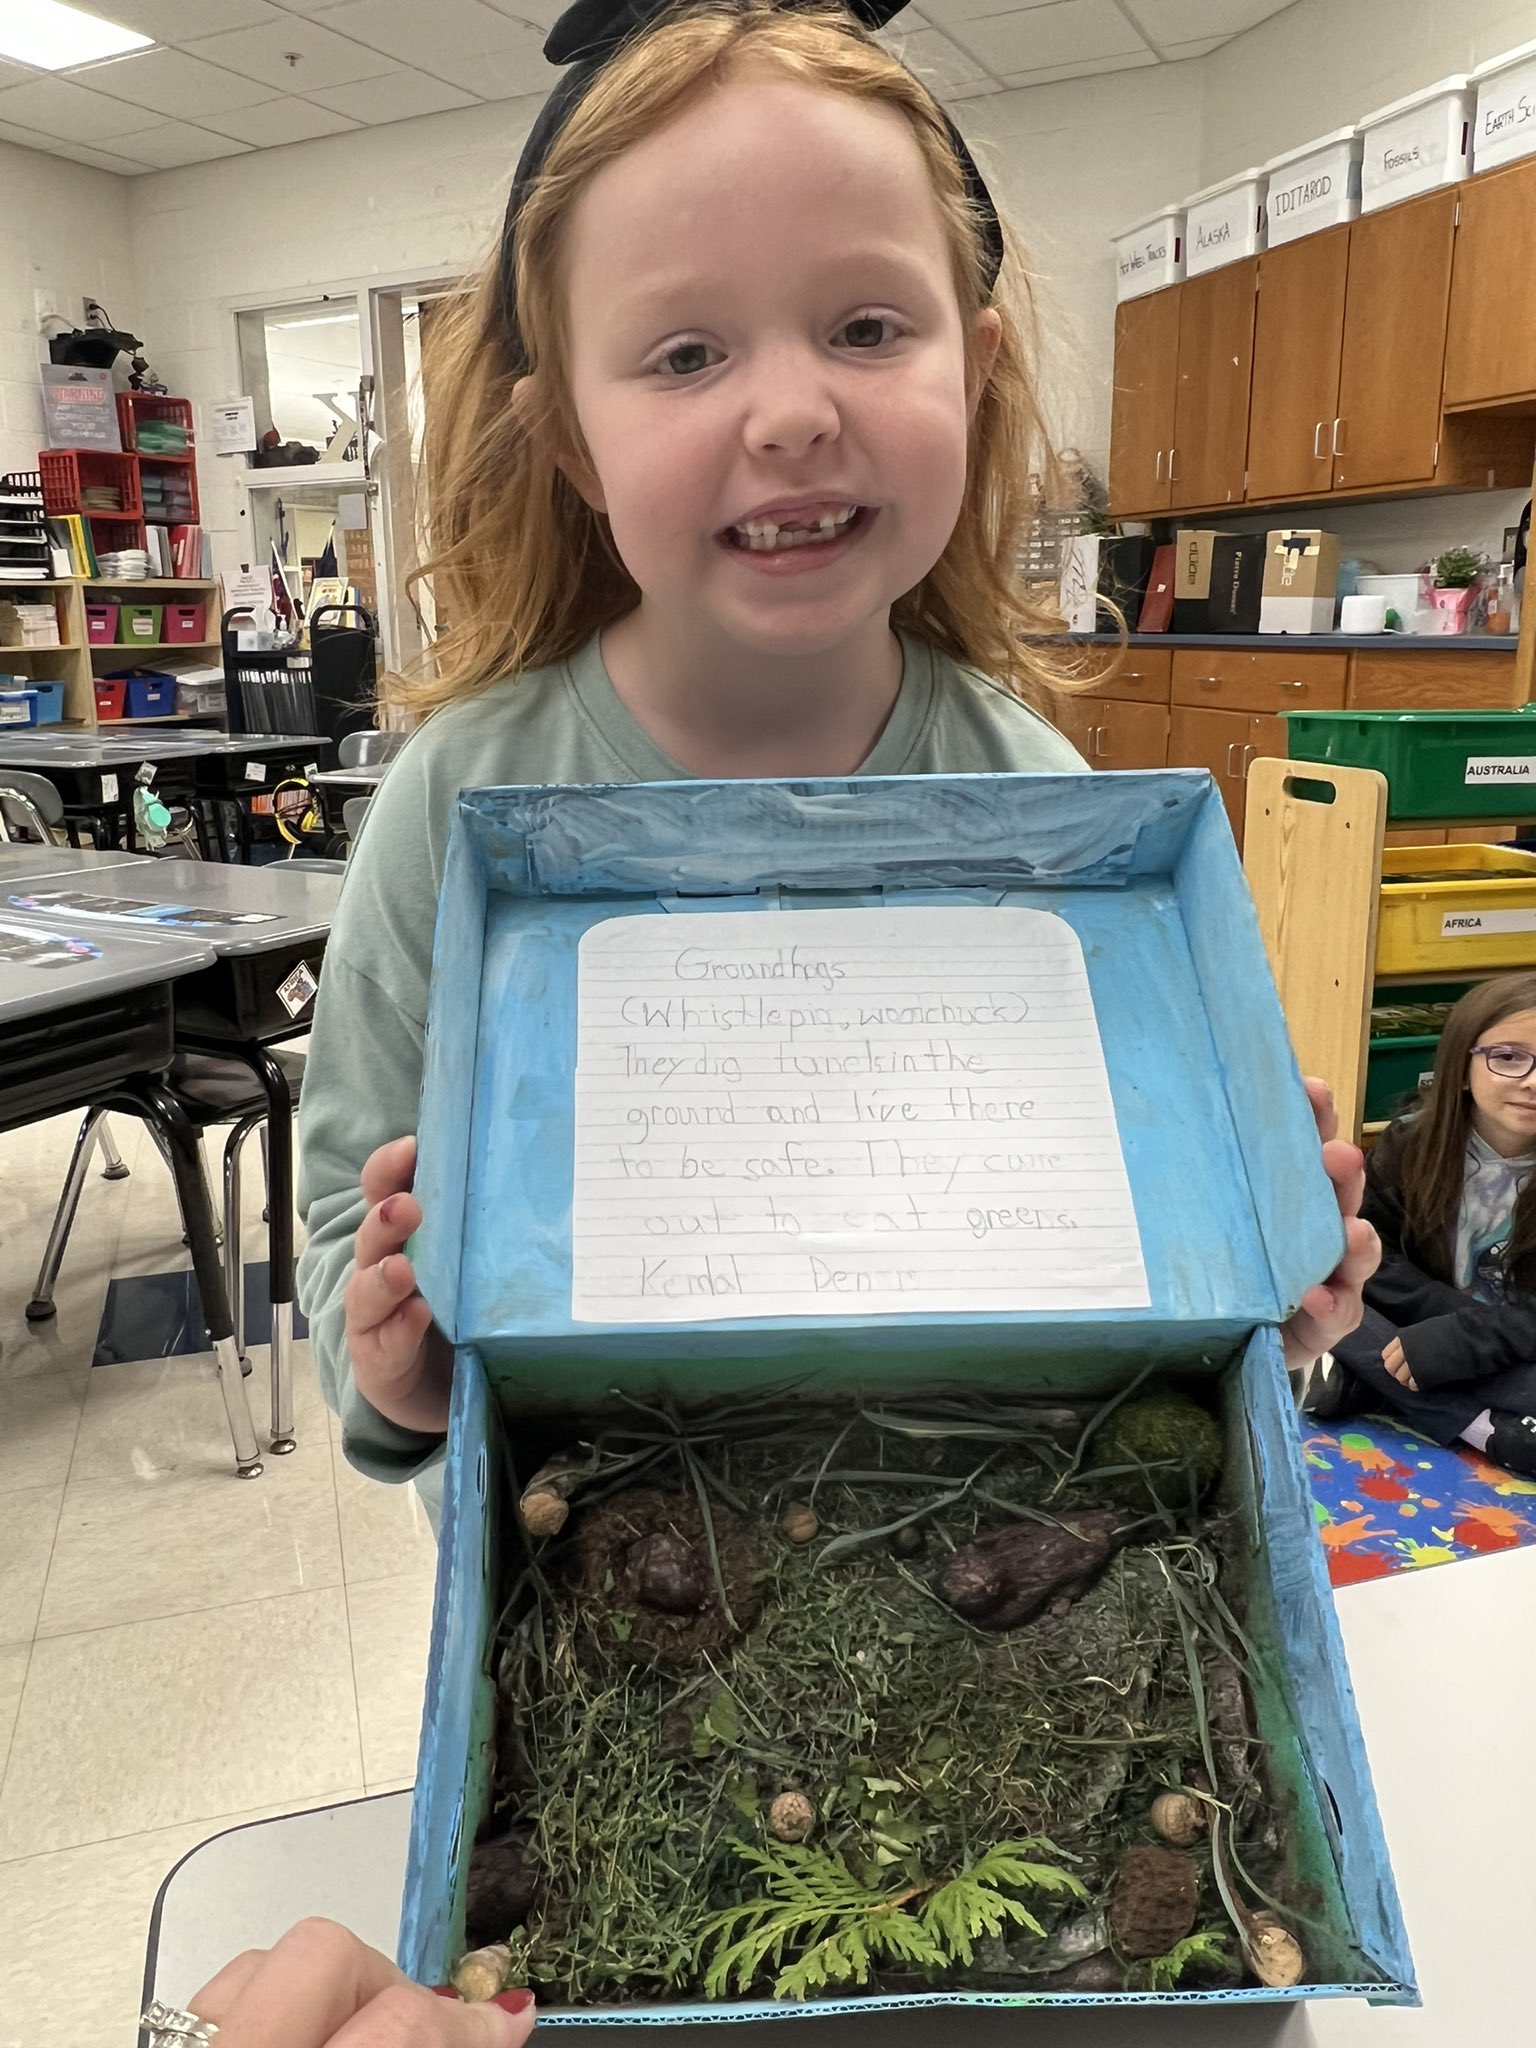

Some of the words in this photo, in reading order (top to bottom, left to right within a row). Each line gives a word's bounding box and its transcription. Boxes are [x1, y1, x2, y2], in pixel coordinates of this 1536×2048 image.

[1275, 176, 1332, 217] IDITAROD
[1196, 222, 1231, 250] ALASKA
[1467, 765, 1530, 776] AUSTRALIA
[1444, 918, 1482, 929] AFRICA
[617, 1044, 684, 1087] They
[694, 1042, 742, 1082] dig
[925, 1039, 990, 1074] the
[627, 1089, 736, 1145] ground
[766, 1090, 822, 1124] and
[854, 1089, 919, 1122] live
[944, 1087, 1036, 1122] there
[610, 1144, 654, 1180] to
[681, 1144, 726, 1179] be
[743, 1140, 836, 1182] safe.
[865, 1139, 962, 1195] They
[644, 1196, 722, 1236] out
[765, 1195, 801, 1236] to
